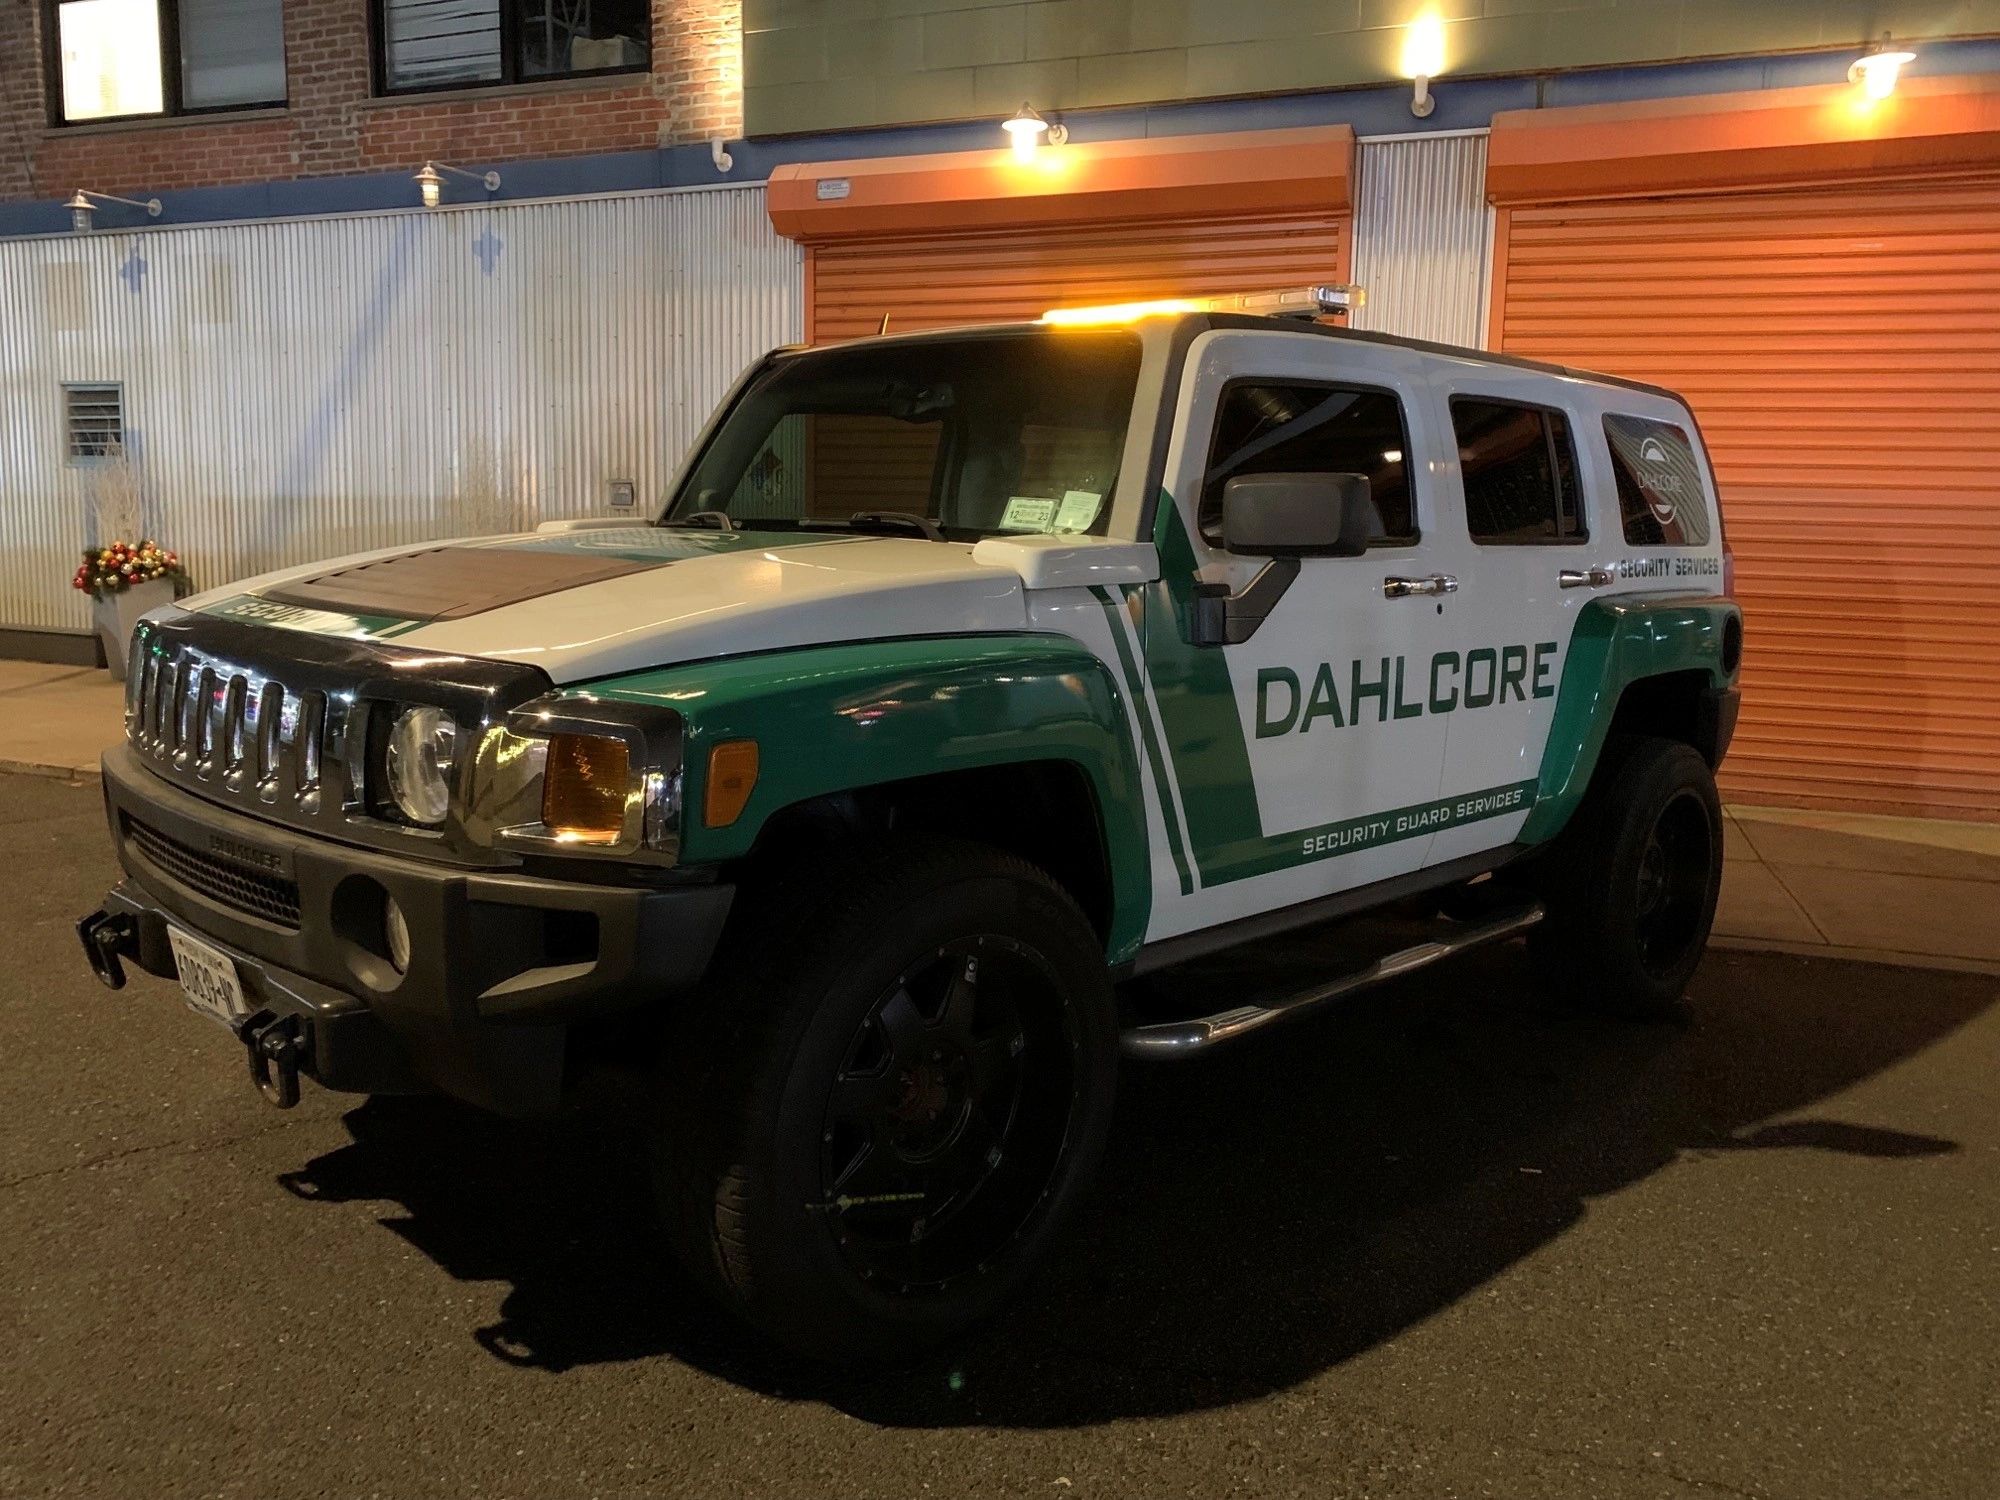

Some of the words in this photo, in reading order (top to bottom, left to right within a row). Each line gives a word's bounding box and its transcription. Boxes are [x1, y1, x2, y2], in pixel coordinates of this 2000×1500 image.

[1620, 558, 1670, 578] SECURITY
[1676, 558, 1718, 576] SERVICES
[1256, 642, 1557, 739] DAHLCORE
[1303, 820, 1390, 855] SECURITY
[1397, 806, 1450, 833] GUARD
[1456, 789, 1524, 818] SERVICES
